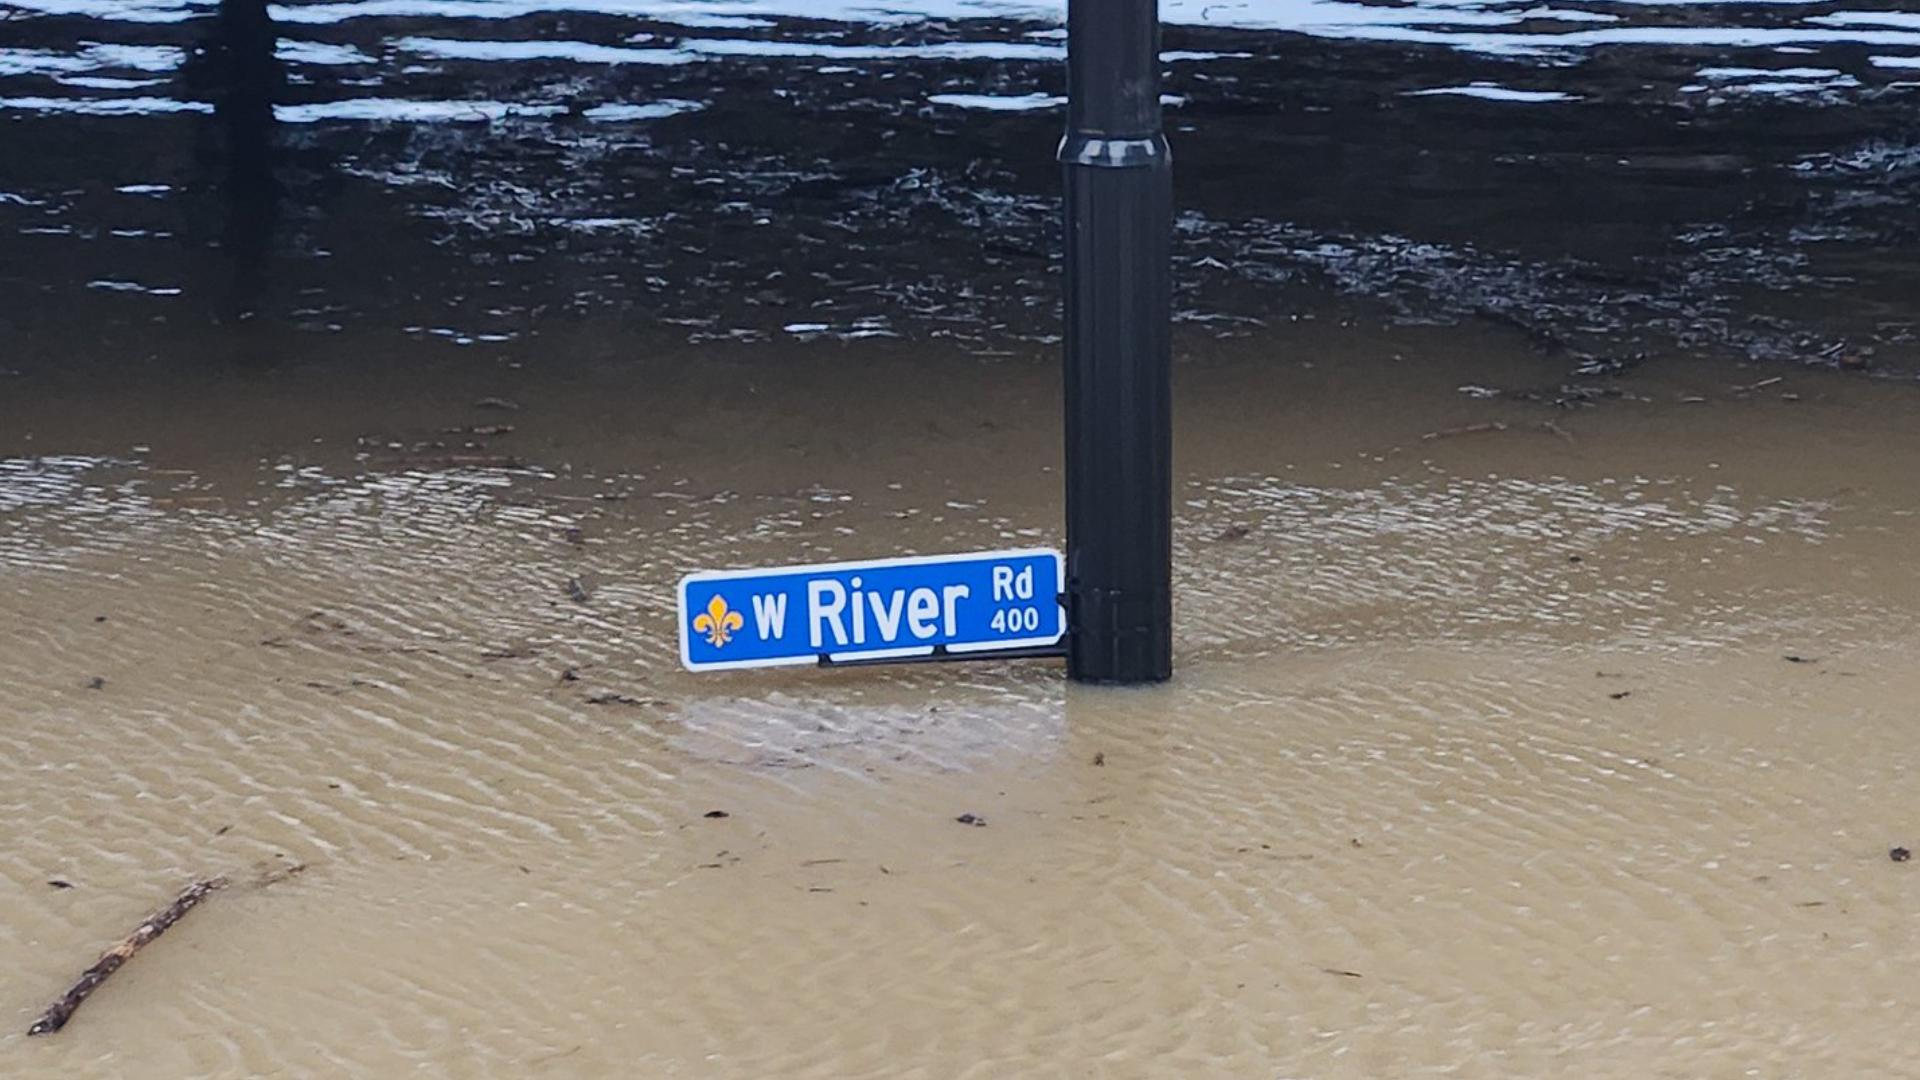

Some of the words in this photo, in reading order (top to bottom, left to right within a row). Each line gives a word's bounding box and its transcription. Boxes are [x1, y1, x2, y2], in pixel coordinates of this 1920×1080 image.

[752, 593, 787, 640] W
[808, 577, 969, 647] River
[993, 566, 1033, 601] Rd
[991, 607, 1039, 632] 400
